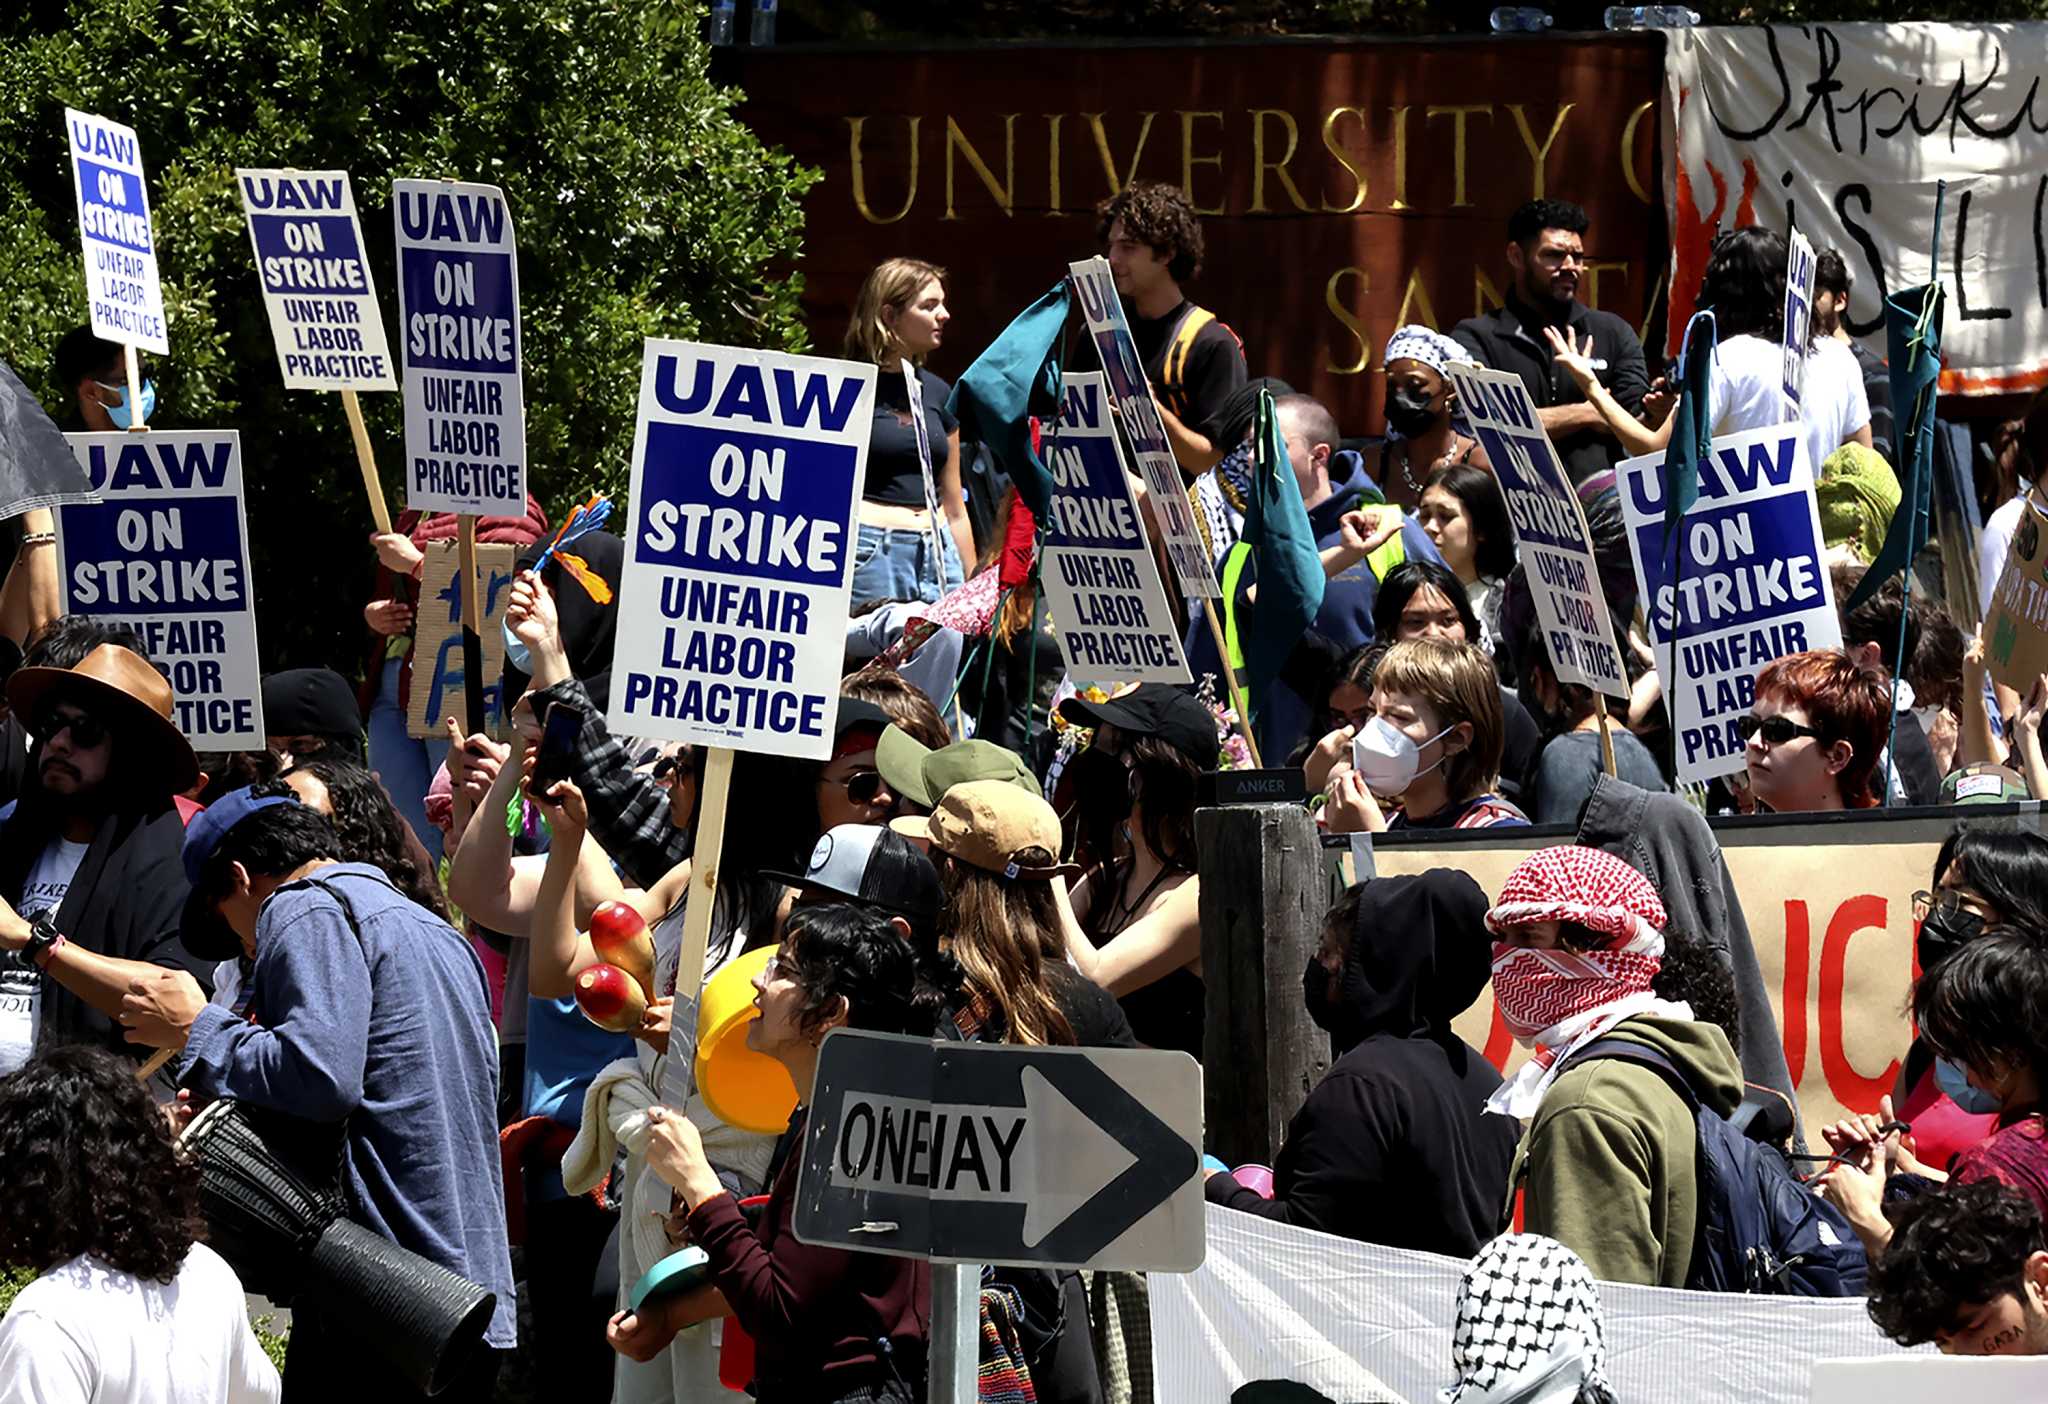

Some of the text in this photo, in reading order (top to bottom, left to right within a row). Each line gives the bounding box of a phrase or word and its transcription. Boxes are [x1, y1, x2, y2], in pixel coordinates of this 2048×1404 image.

[73, 120, 135, 166] UAW
[844, 102, 1577, 224] UNIVERSITY
[97, 170, 127, 207] ON
[243, 176, 343, 210] UAW
[83, 200, 149, 250] STRIKE
[283, 221, 325, 253] ON
[400, 191, 505, 244] UAW
[96, 249, 146, 279] UNFAIR
[264, 256, 367, 290] STRIKE
[433, 260, 475, 307] ON
[102, 276, 147, 308] LABOR
[282, 299, 360, 324] UNFAIR
[96, 302, 163, 340] PRACTICE
[293, 327, 364, 352] LABOR
[408, 312, 513, 363] STRIKE
[285, 354, 388, 379] PRACTICE
[422, 376, 503, 416] UNFAIR
[655, 354, 865, 433] UAW
[428, 418, 501, 457] LABOR
[414, 458, 520, 500] PRACTICE
[709, 442, 786, 502] ON
[1045, 444, 1090, 489] ON
[117, 507, 184, 552] ON
[644, 500, 841, 573] STRIKE
[1040, 493, 1136, 541] TRIKE
[1507, 487, 1583, 543] STRIKE
[1689, 512, 1755, 567] ON
[73, 558, 240, 604] STRIKE
[1056, 553, 1142, 590] UNFAIR
[1656, 555, 1819, 631] STRIKE
[660, 576, 810, 635] UNFAIR
[1072, 592, 1149, 628] LABOR
[661, 627, 796, 683] LABOR
[1065, 631, 1180, 667] PRACTICE
[1549, 630, 1621, 681] PRCTICE
[1682, 620, 1808, 680] UNFAIR
[624, 672, 827, 737] PRACTICE
[1695, 674, 1756, 719] LAB
[1236, 779, 1286, 793] ANKER
